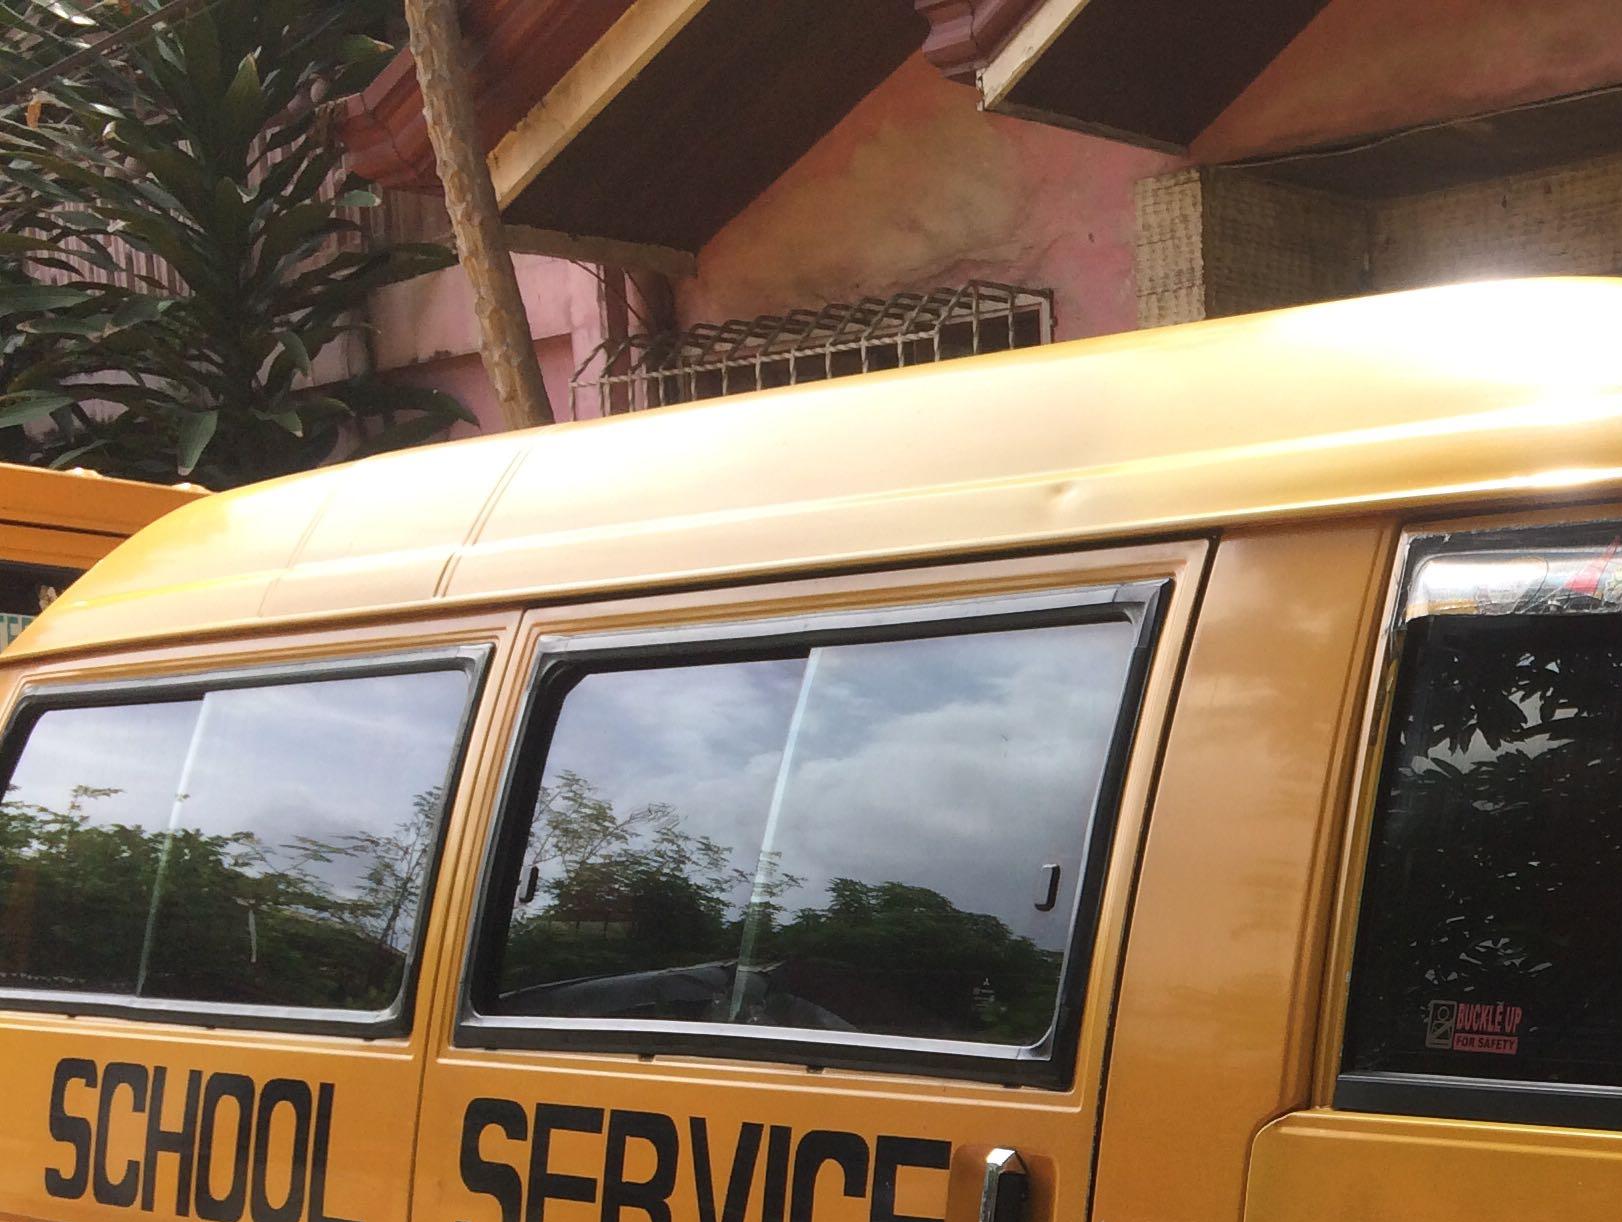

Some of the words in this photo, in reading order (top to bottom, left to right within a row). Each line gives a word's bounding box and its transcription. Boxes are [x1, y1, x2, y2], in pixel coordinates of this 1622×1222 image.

[1456, 1003, 1504, 1033] BUCKLE
[1505, 1006, 1523, 1033] UP
[1455, 1037, 1475, 1048] FOR
[1478, 1037, 1516, 1050] SAFETY
